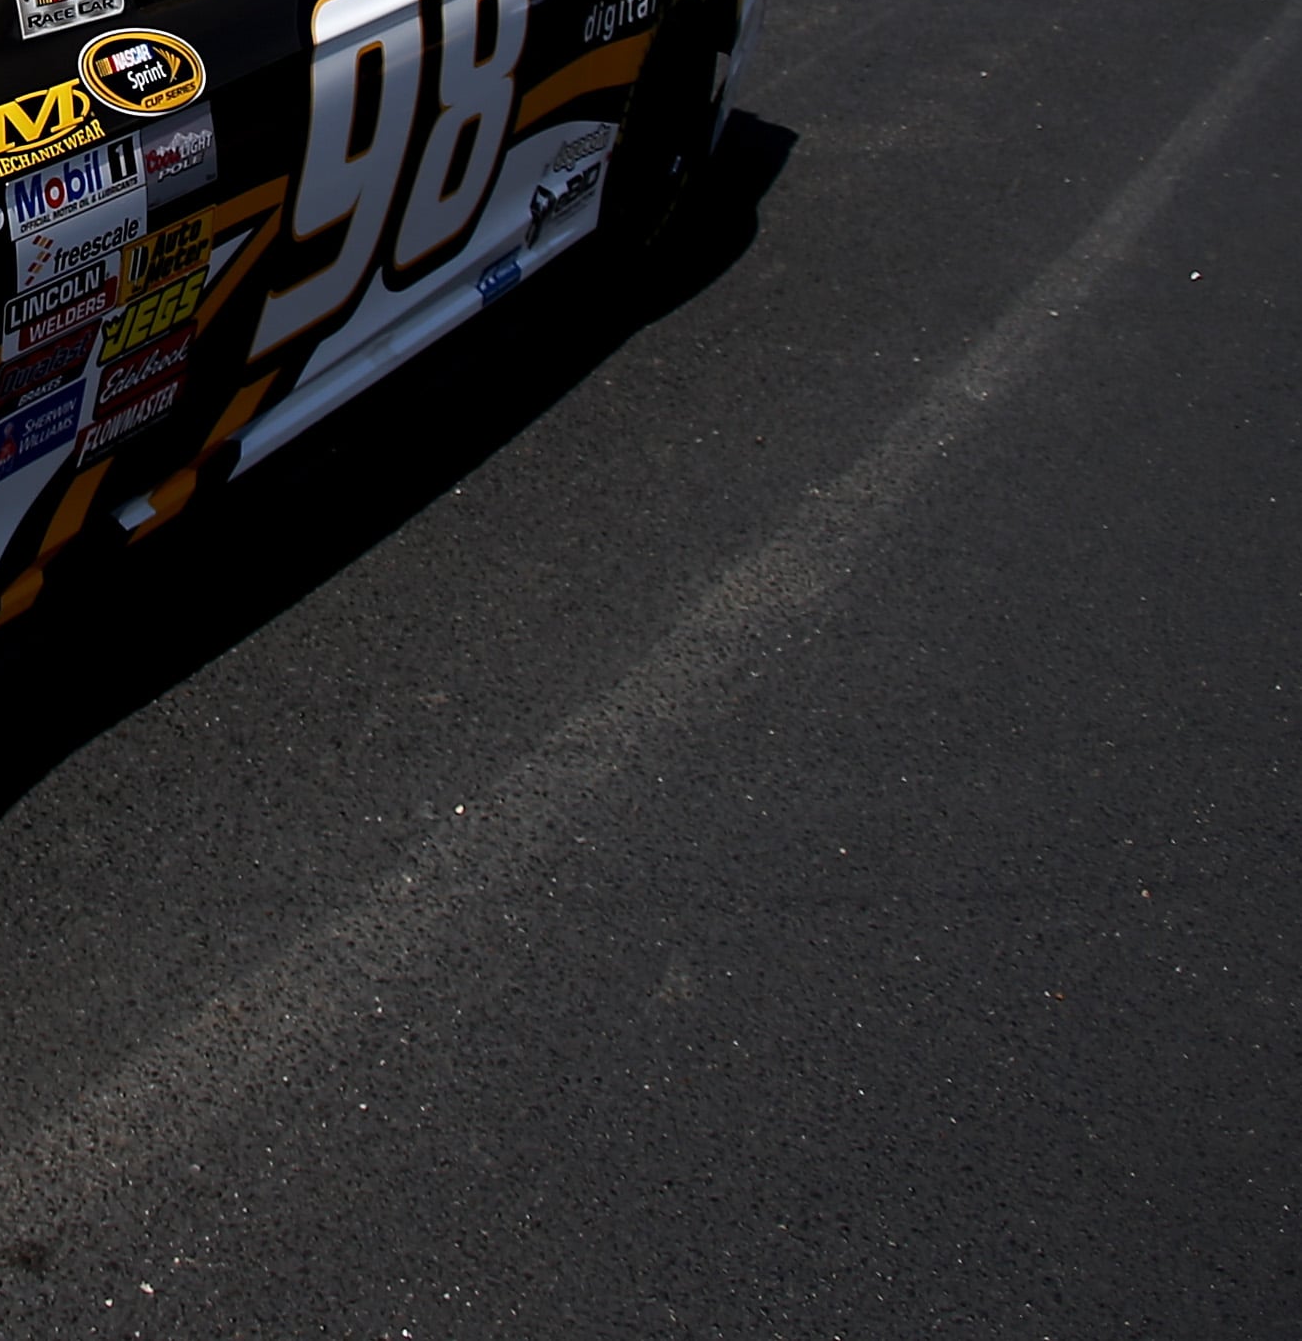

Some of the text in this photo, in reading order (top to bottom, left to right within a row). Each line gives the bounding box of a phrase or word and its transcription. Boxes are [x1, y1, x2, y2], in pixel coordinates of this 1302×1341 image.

[27, 7, 75, 29] RACE
[111, 42, 154, 73] NASCAR
[126, 60, 168, 91] Sprint
[145, 81, 196, 109] CUP SERIES
[62, 118, 107, 149] WEAR
[14, 149, 103, 224] Mobil
[157, 152, 205, 183] POLE
[20, 214, 52, 234] OFFICIAL
[52, 204, 78, 223] MOTOR
[79, 198, 91, 212] OIL
[97, 176, 139, 201] LUBRICANTS
[53, 217, 140, 274] freescale
[10, 265, 100, 329] LINCOLN
[28, 291, 107, 343] WELDERS
[99, 269, 209, 363] JEGS
[99, 332, 193, 405] Edelbrock
[17, 374, 63, 407] BRAKES
[19, 415, 74, 455] WILLIAMS
[23, 397, 77, 435] SHERWIN
[76, 380, 180, 469] FLOWMASTER
